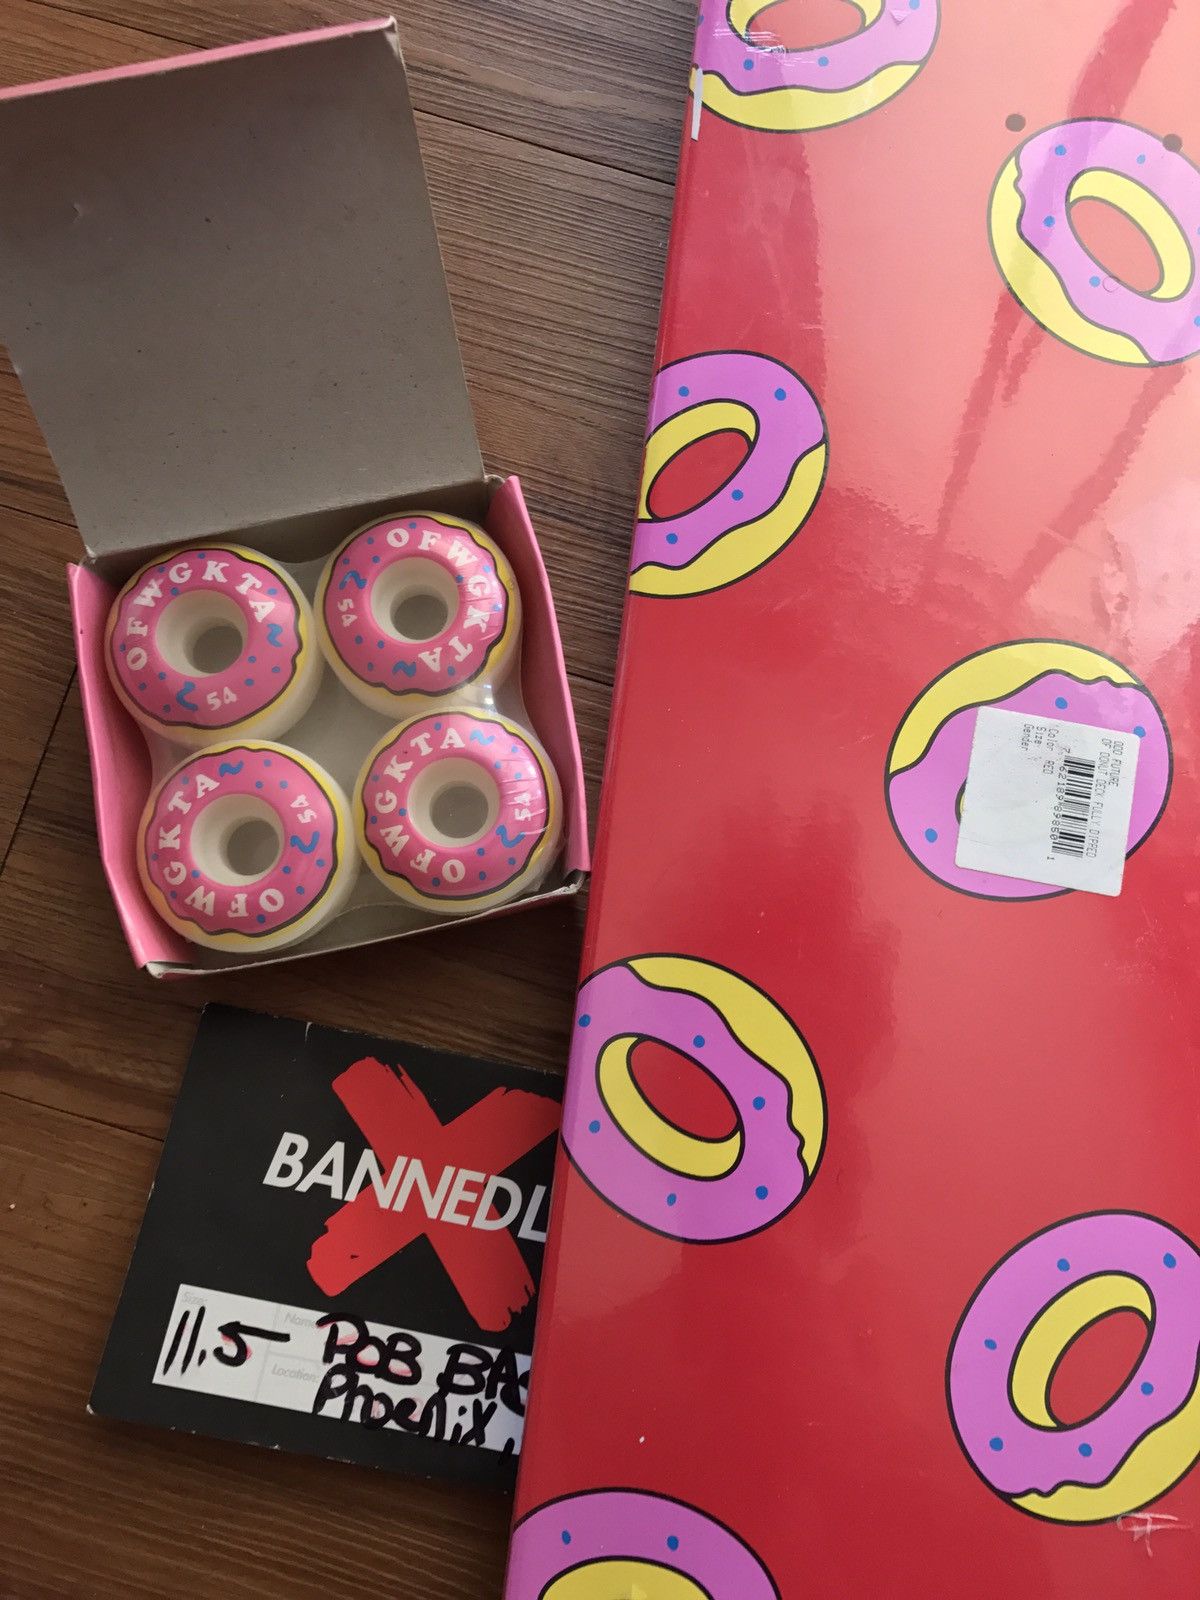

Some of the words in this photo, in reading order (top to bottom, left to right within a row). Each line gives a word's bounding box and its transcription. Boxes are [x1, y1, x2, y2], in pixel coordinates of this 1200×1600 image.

[337, 598, 358, 628] 54
[387, 528, 493, 673] OFWGKTA
[125, 559, 276, 671] OFWGKTA
[207, 687, 237, 711] 54
[1021, 724, 1034, 751] Gender
[1042, 760, 1055, 775] RED
[1098, 752, 1110, 776] DONUT
[1108, 760, 1122, 787] FUTURE
[1094, 778, 1107, 799] DECK
[290, 794, 317, 824] 54
[373, 728, 466, 884] OFWGKTA
[1090, 801, 1104, 827] FULLY
[157, 772, 284, 918] OFWGKTA
[1085, 828, 1100, 858] DIPPED
